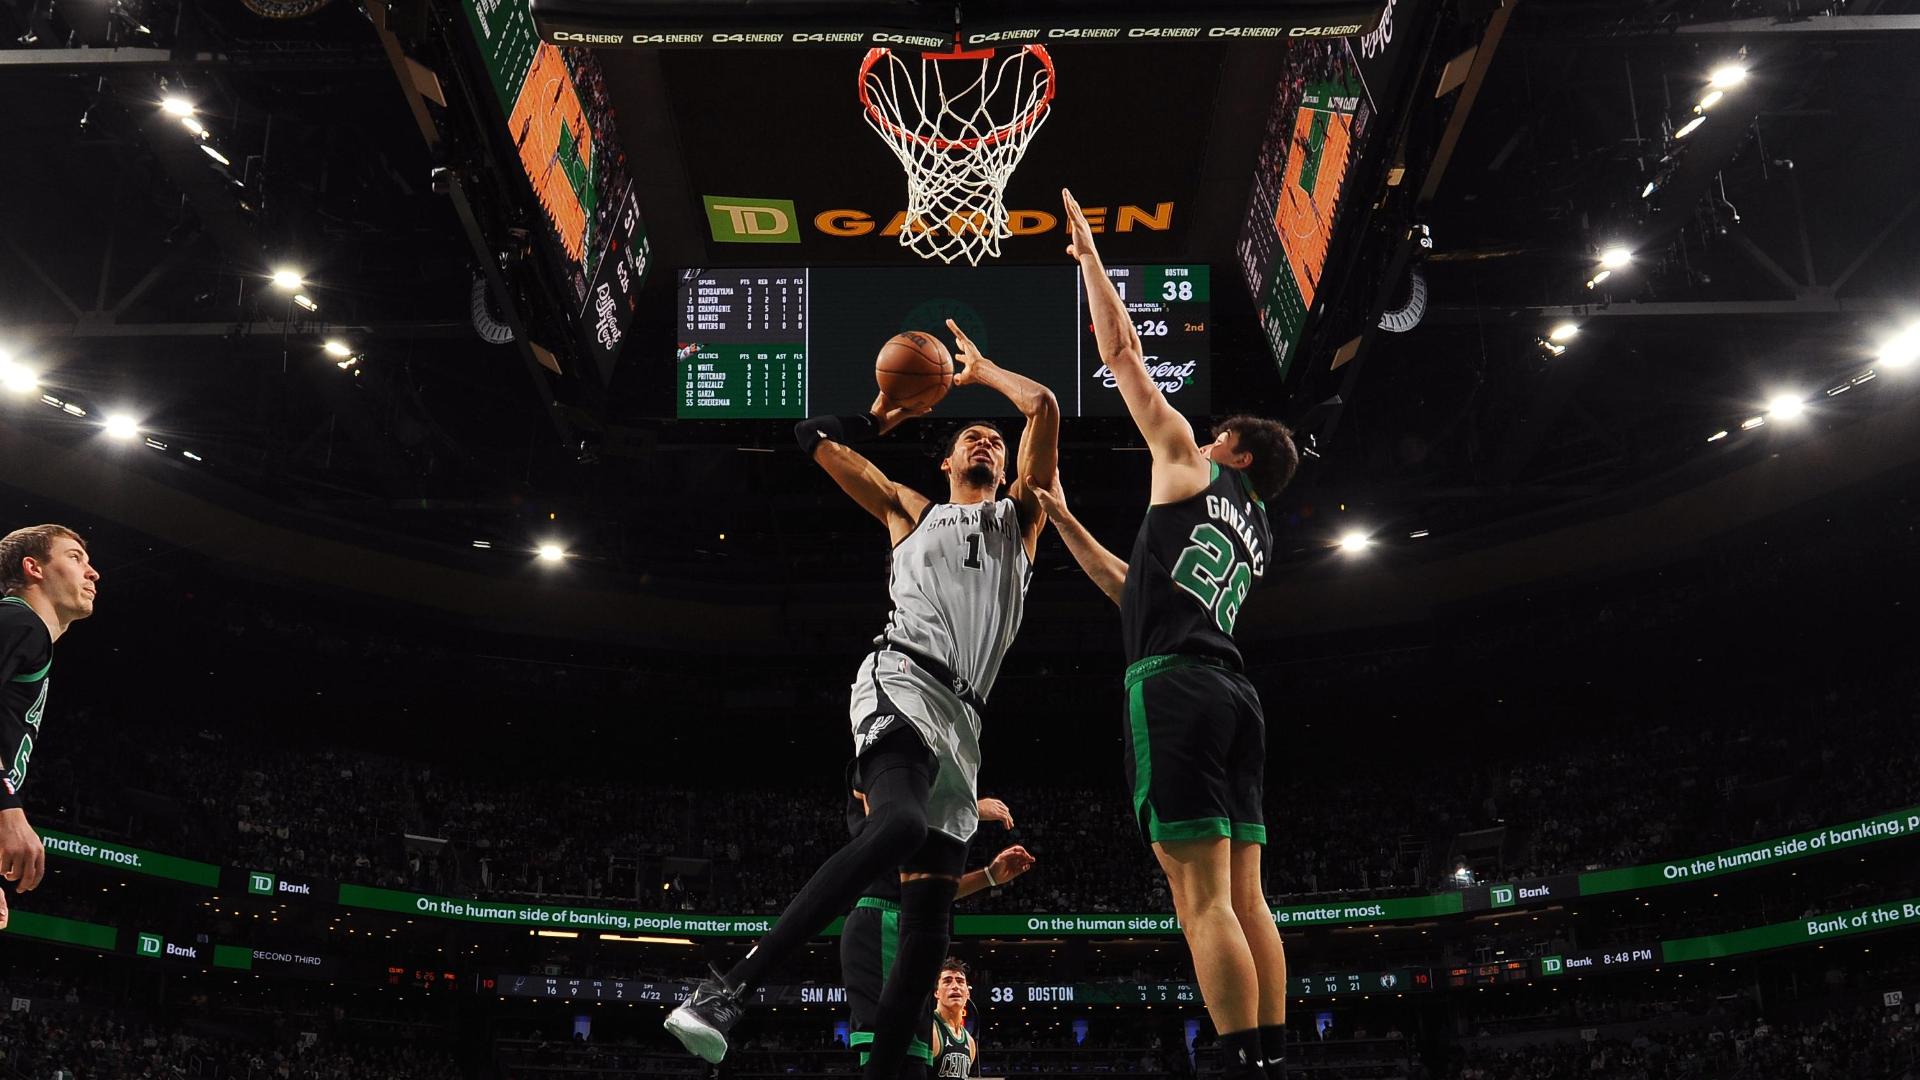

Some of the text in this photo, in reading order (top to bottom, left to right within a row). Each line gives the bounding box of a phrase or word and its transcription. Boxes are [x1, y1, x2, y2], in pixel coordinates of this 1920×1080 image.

[713, 202, 1175, 236] TD GARDEN
[1165, 268, 1188, 276] BOSTON
[1117, 281, 1193, 301] 1 38
[596, 282, 622, 342] Different
[1136, 320, 1204, 336] :26 2nd
[698, 372, 726, 380] PRITCHARD
[927, 514, 958, 531] SAN
[962, 533, 983, 571] 1
[1171, 523, 1251, 635] 28
[43, 835, 142, 867] matter most.
[1663, 864, 1689, 879] On
[1691, 860, 1716, 875] the
[1717, 848, 1772, 869] human
[1773, 838, 1808, 857] side
[1810, 833, 1827, 849] of
[1829, 817, 1904, 845] banking,
[252, 876, 310, 895] TD Bank
[1493, 885, 1550, 904] TD Bank
[416, 898, 772, 932] On the human side of banking, people matter most.
[1293, 908, 1341, 920] matter
[1344, 904, 1385, 917] most.
[1028, 918, 1048, 930] On
[1051, 917, 1074, 930] the
[1077, 917, 1125, 930] human
[1128, 917, 1157, 930] side
[1159, 917, 1174, 930] of
[1807, 918, 1849, 936] Bank
[1851, 911, 1868, 927] of
[1871, 908, 1899, 923] the
[140, 937, 197, 958] TD Bank
[253, 951, 321, 965] SECOND THIRD
[1544, 949, 1652, 972] TD Bank 8:48 PM
[1305, 985, 1311, 993] 2
[1327, 984, 1337, 992] 10
[1350, 982, 1360, 991] 21
[1416, 976, 1427, 984] 10
[547, 986, 557, 995] 16
[572, 988, 577, 996] 9
[617, 990, 623, 998] 2
[640, 991, 661, 1000] 4/22
[801, 988, 823, 1002] SAN
[990, 987, 1074, 1002] 38 BOSTON
